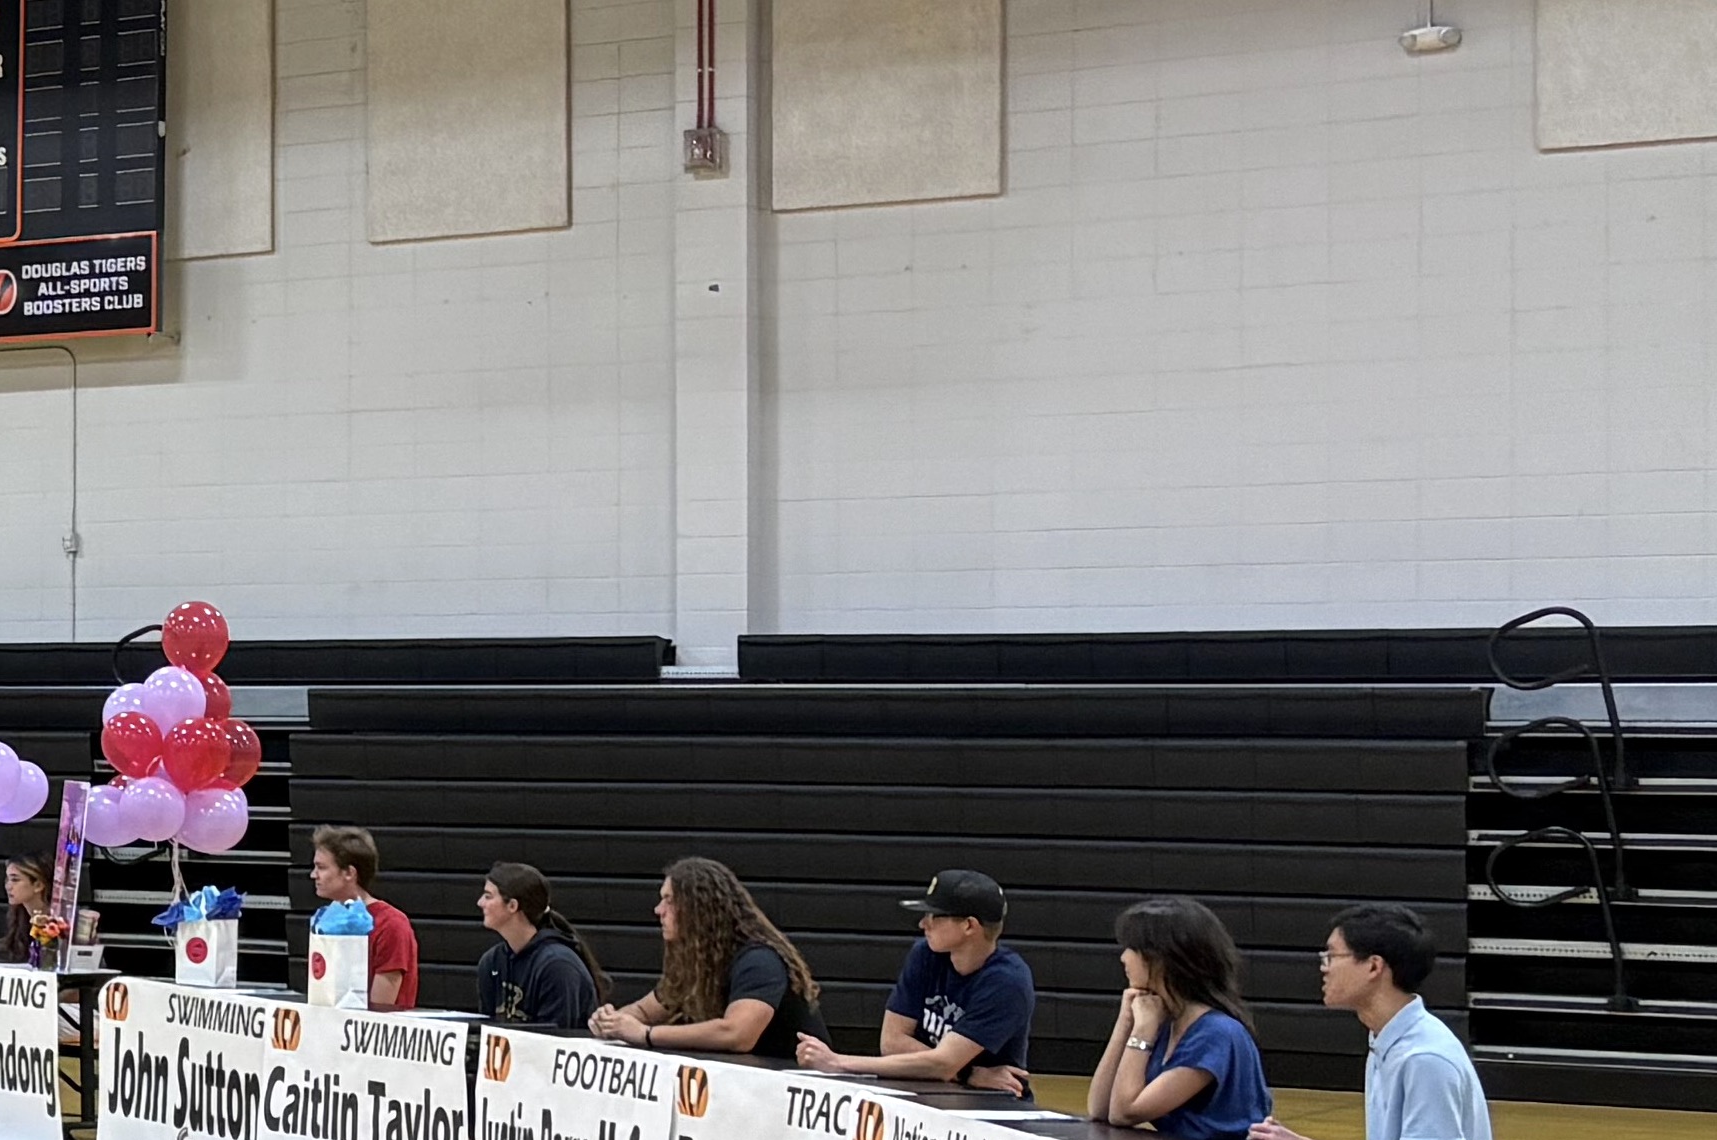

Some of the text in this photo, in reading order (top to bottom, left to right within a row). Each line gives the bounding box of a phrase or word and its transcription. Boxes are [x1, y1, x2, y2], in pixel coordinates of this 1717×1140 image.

[21, 254, 146, 278] DOUGLAS TIGERS
[37, 275, 130, 297] ALL-SPORTS
[23, 293, 144, 316] BOOSTERS CLUB
[166, 993, 265, 1038] SWIMMING
[341, 1019, 456, 1066] SWIMMING
[108, 1027, 168, 1123] John
[553, 1049, 658, 1101] FOOTBALL
